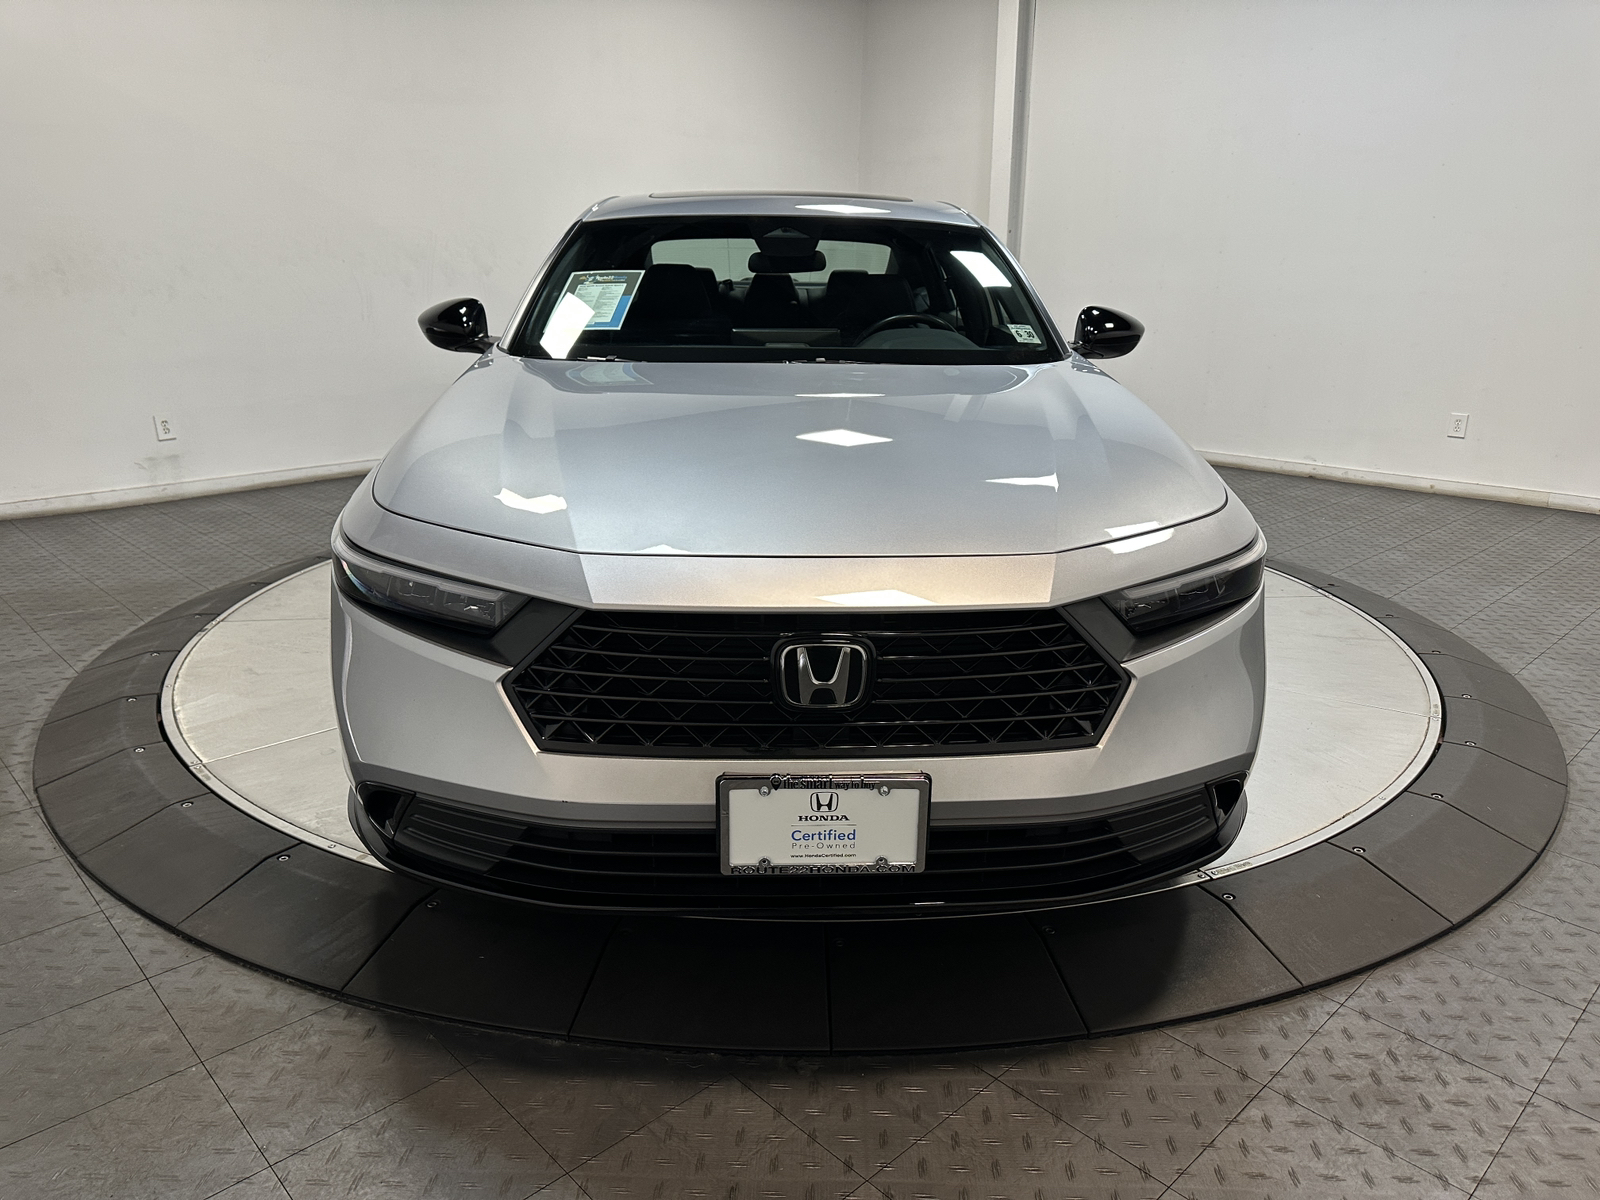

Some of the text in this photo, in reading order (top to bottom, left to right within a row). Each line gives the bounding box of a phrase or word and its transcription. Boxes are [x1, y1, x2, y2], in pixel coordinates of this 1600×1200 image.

[1015, 330, 1022, 338] 6
[783, 774, 799, 789] the
[800, 774, 833, 789] smart
[834, 780, 851, 790] way
[851, 779, 859, 789] to
[791, 829, 856, 841] Certified
[791, 842, 856, 850] Pre-Owned
[730, 865, 915, 874] ROUTE22HONDA.COM
